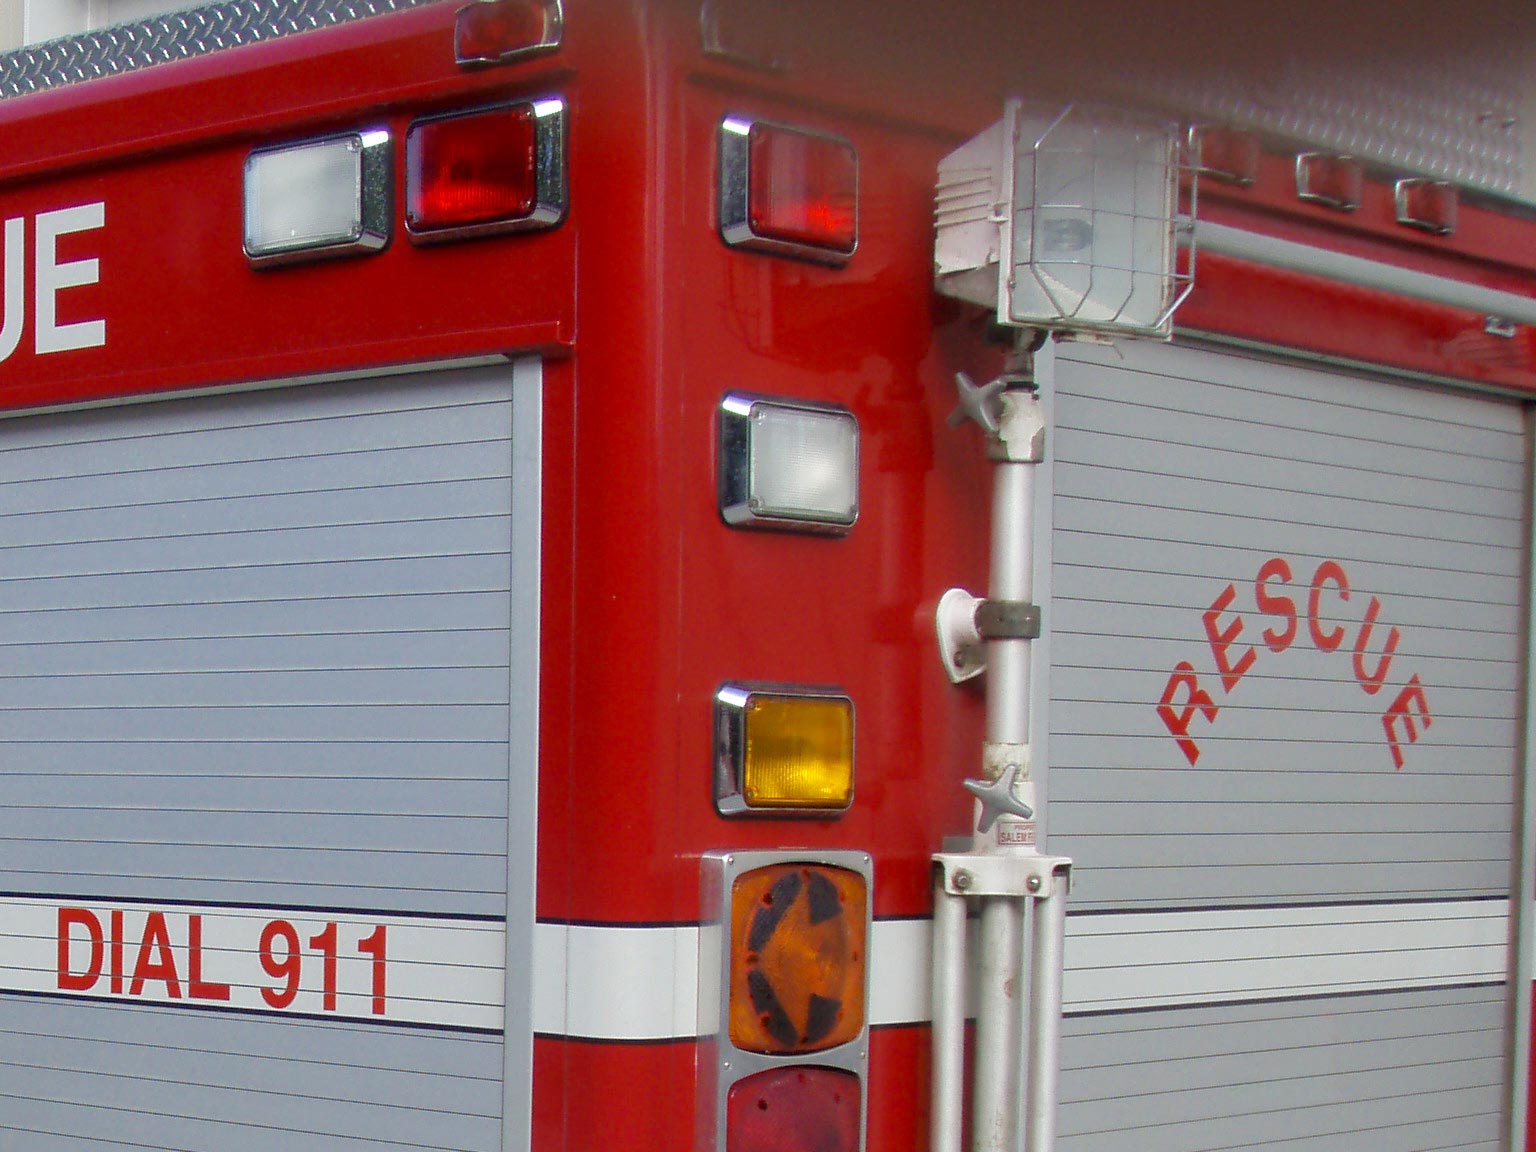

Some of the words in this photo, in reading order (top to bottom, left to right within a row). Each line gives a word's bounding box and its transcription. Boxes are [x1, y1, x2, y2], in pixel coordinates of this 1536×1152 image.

[1156, 558, 1432, 771] RESCUE
[1000, 832, 1027, 843] SALEM
[57, 907, 231, 1001] DIAL
[259, 919, 387, 1015] 911
